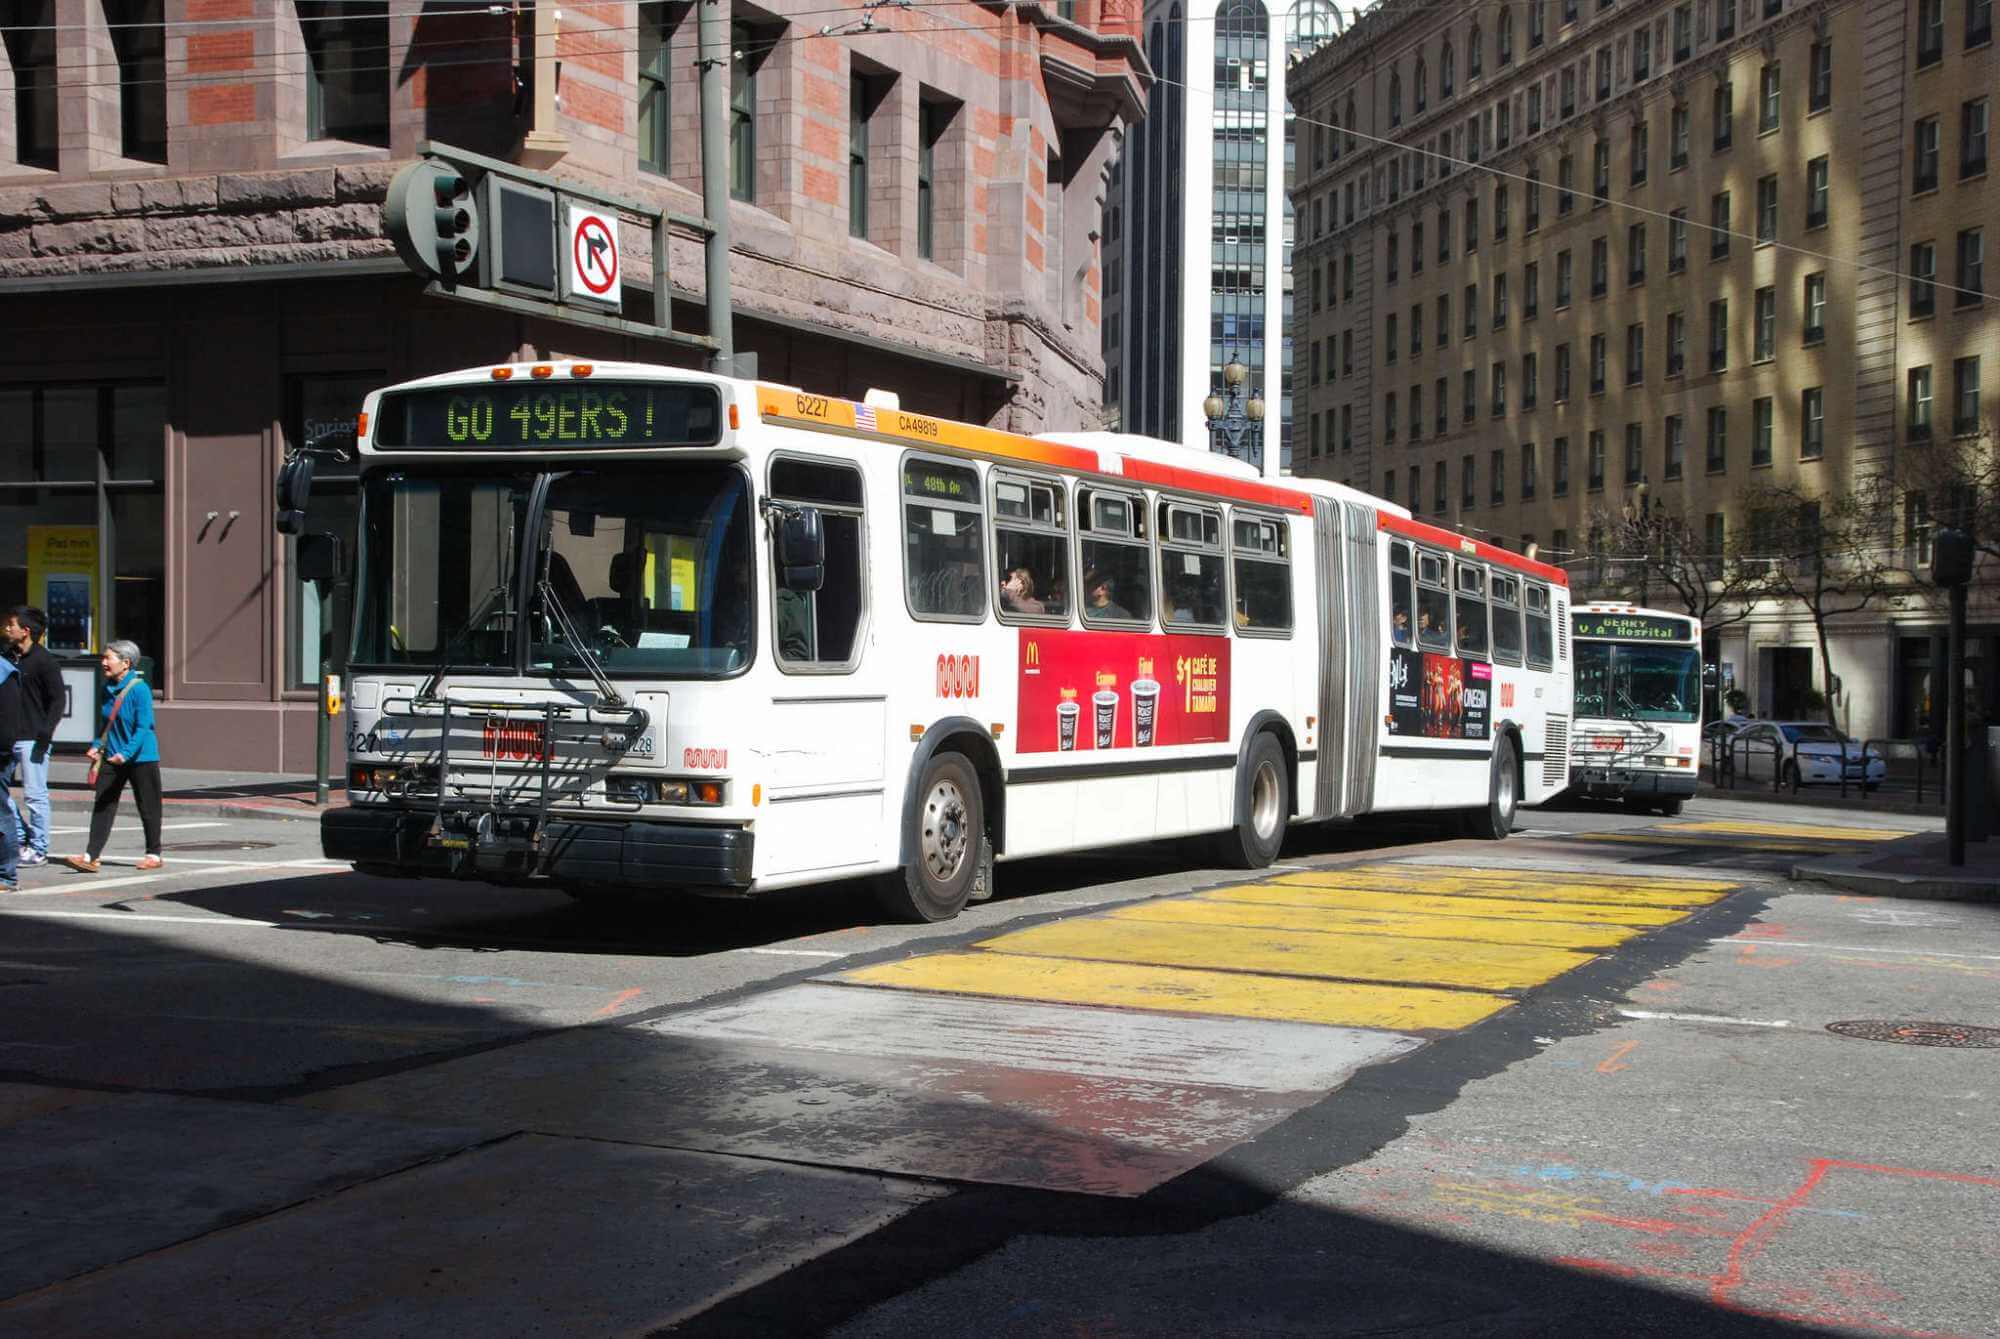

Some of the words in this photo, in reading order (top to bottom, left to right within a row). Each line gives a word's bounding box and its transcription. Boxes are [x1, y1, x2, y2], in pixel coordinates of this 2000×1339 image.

[448, 396, 493, 441] GO
[510, 393, 628, 440] 49ERS
[796, 394, 829, 418] 6227
[899, 414, 938, 437] CA49819
[1617, 627, 1673, 638] Hospital
